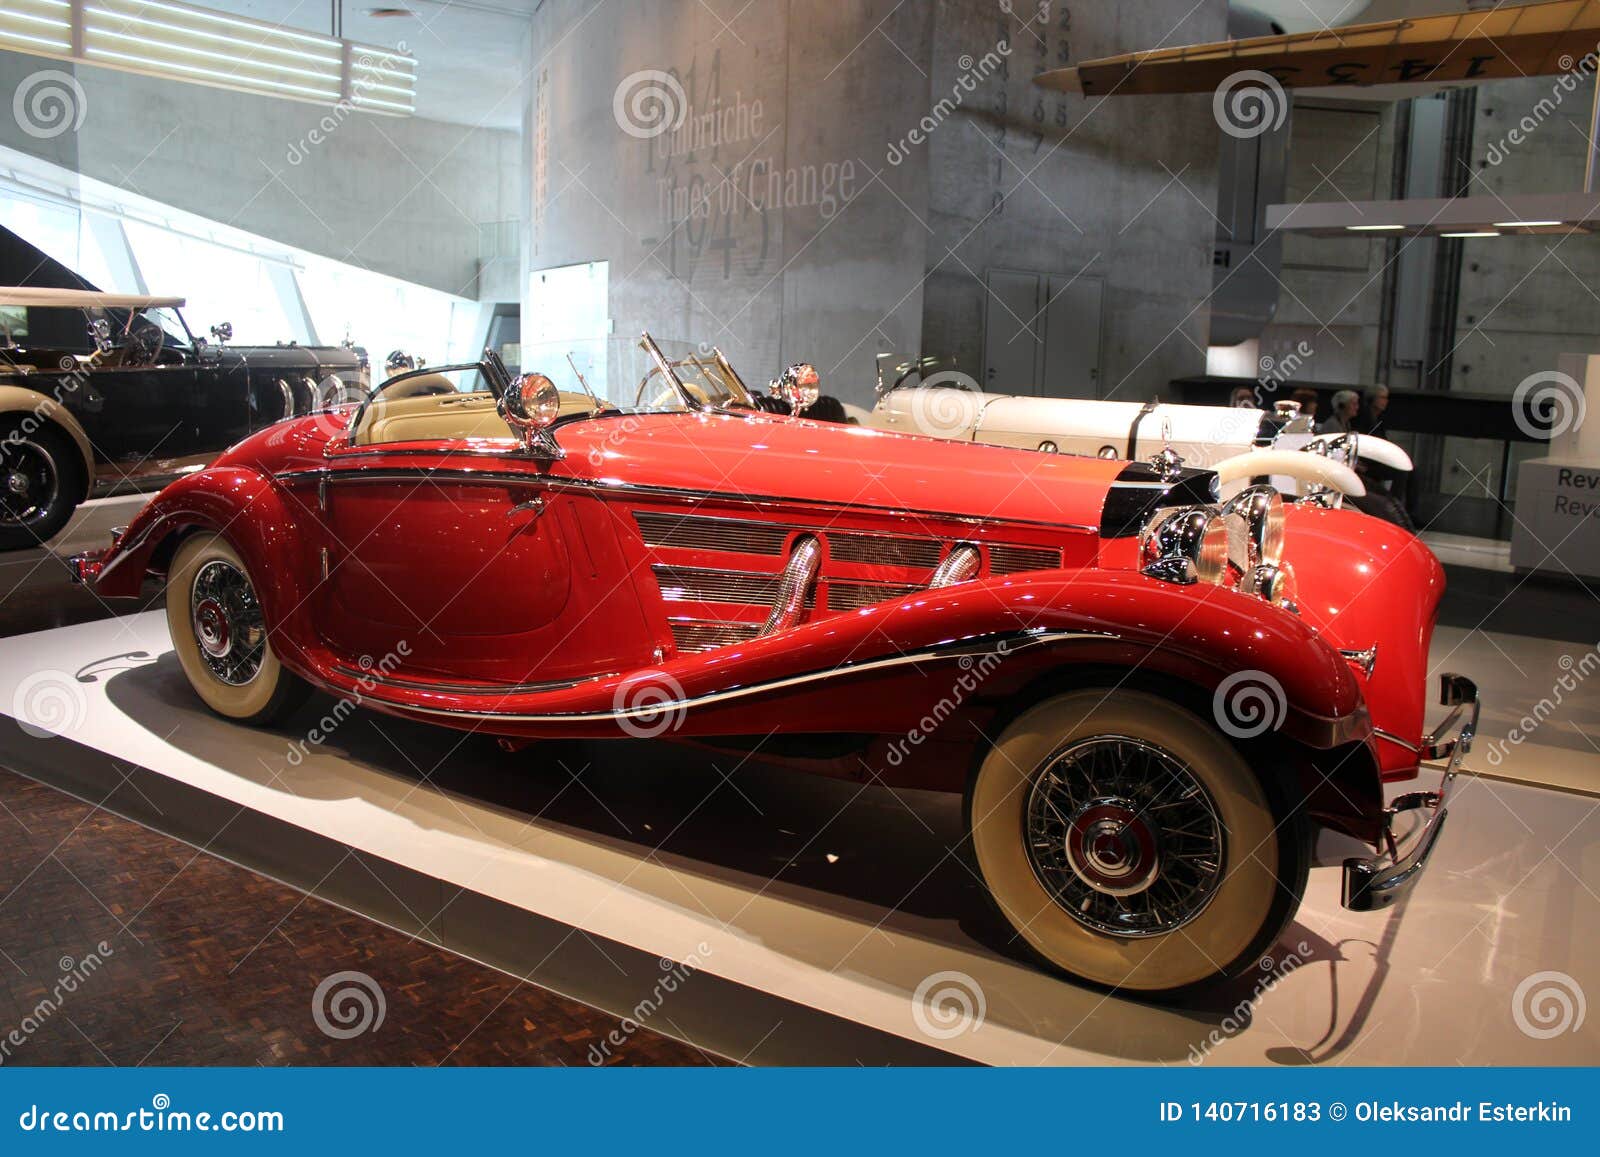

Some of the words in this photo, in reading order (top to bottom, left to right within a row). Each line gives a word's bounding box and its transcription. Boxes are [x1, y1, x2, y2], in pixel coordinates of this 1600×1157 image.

[656, 178, 712, 224] Times
[719, 162, 745, 216] of
[749, 157, 856, 219] Change
